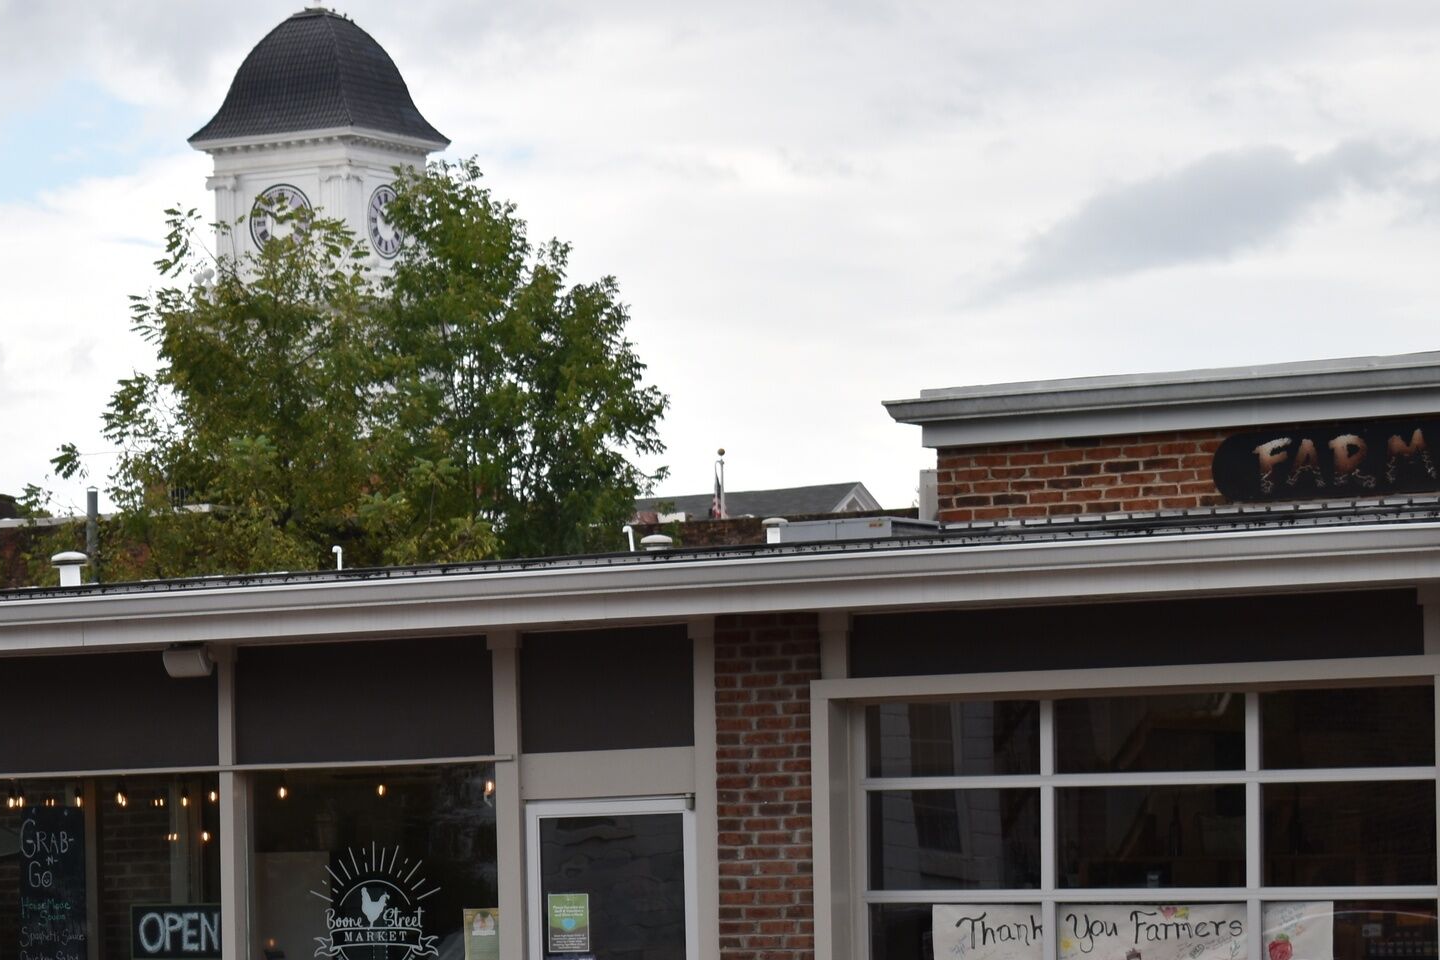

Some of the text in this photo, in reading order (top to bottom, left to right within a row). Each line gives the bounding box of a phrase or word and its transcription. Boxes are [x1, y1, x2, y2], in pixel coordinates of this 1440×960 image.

[138, 912, 220, 954] OPEN
[324, 906, 426, 930] Boone Street
[1065, 913, 1118, 953] You
[1129, 910, 1243, 945] Farmers
[343, 930, 407, 942] MARKET
